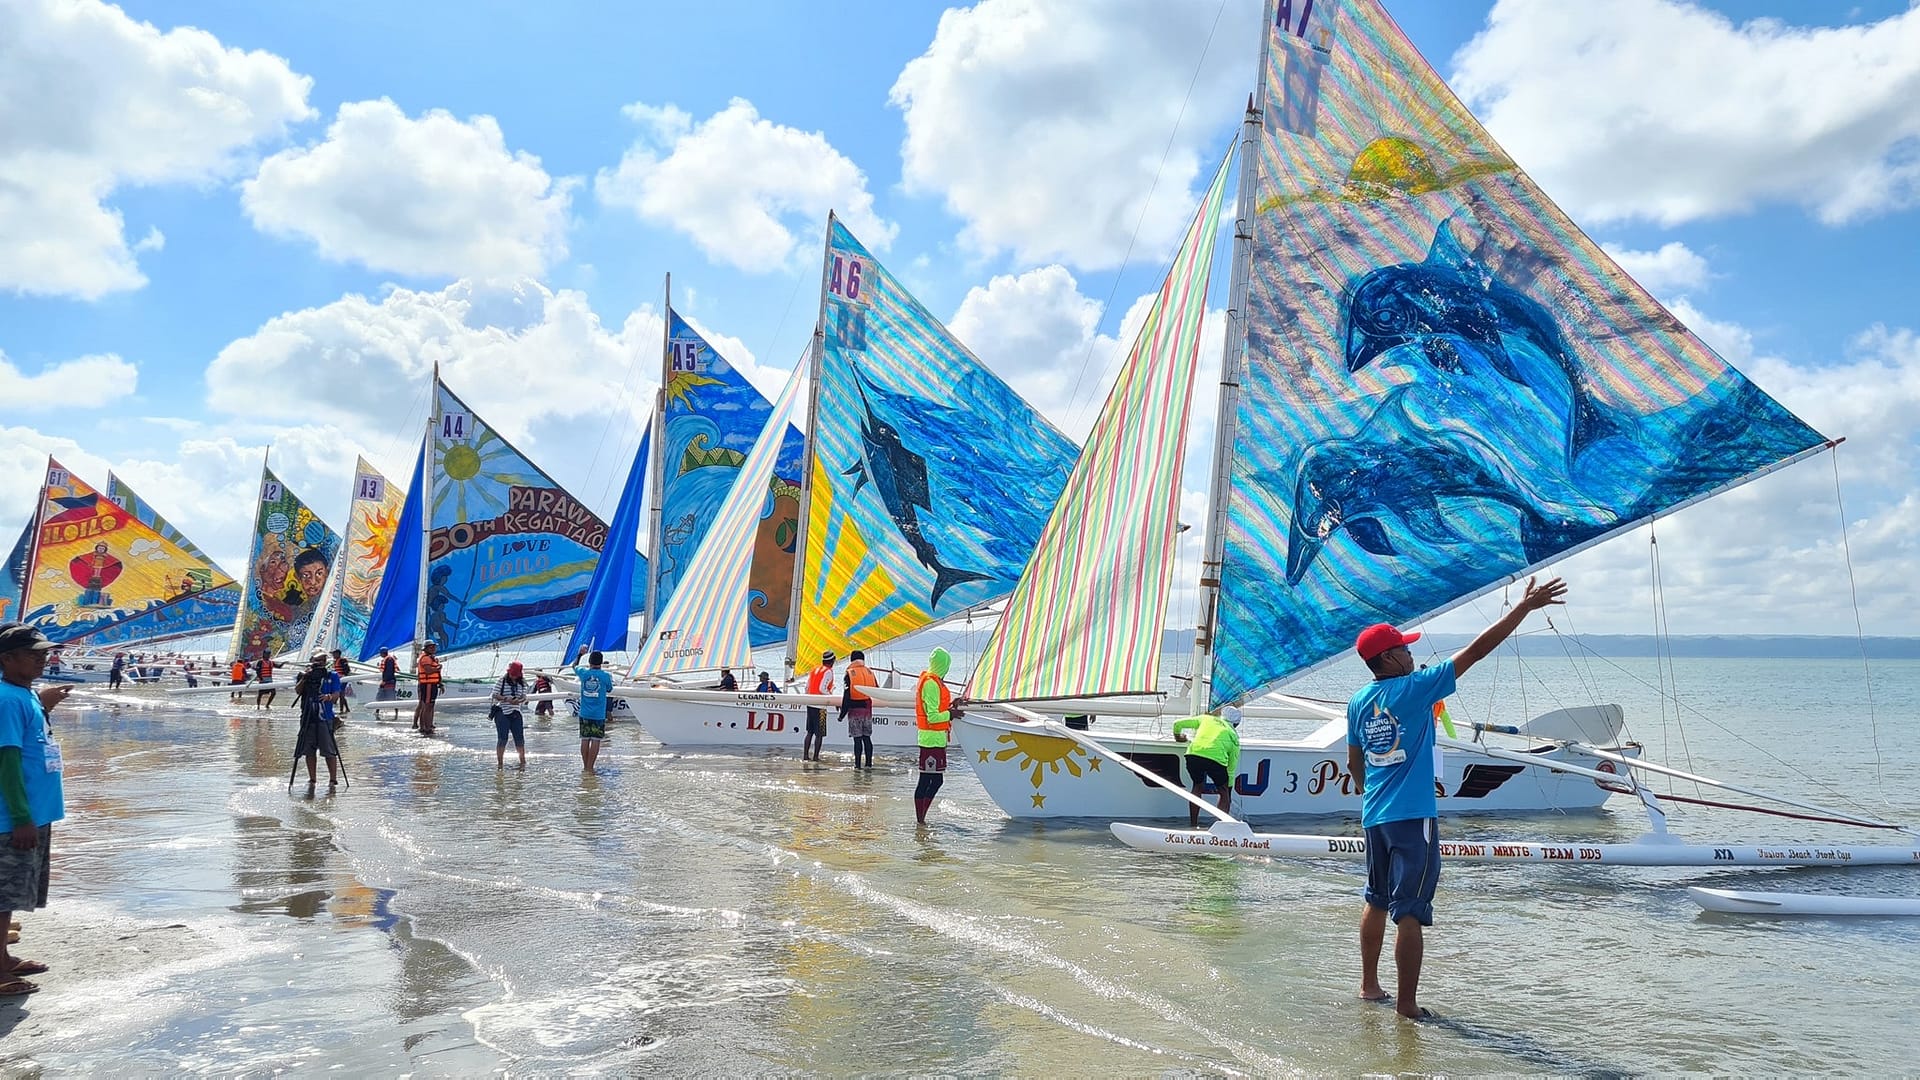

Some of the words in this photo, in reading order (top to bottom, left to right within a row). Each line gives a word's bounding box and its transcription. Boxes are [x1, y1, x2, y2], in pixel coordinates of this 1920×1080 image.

[509, 487, 591, 524] PARAW
[43, 515, 117, 545] ILOILO
[503, 512, 584, 543] REGATTA
[480, 554, 550, 582] ILOILO
[663, 647, 704, 659] OUTDOORS
[738, 693, 776, 701] LEGANES
[1209, 836, 1239, 848] Beach
[1541, 847, 1574, 860] TEAM
[1788, 848, 1812, 859] Beach
